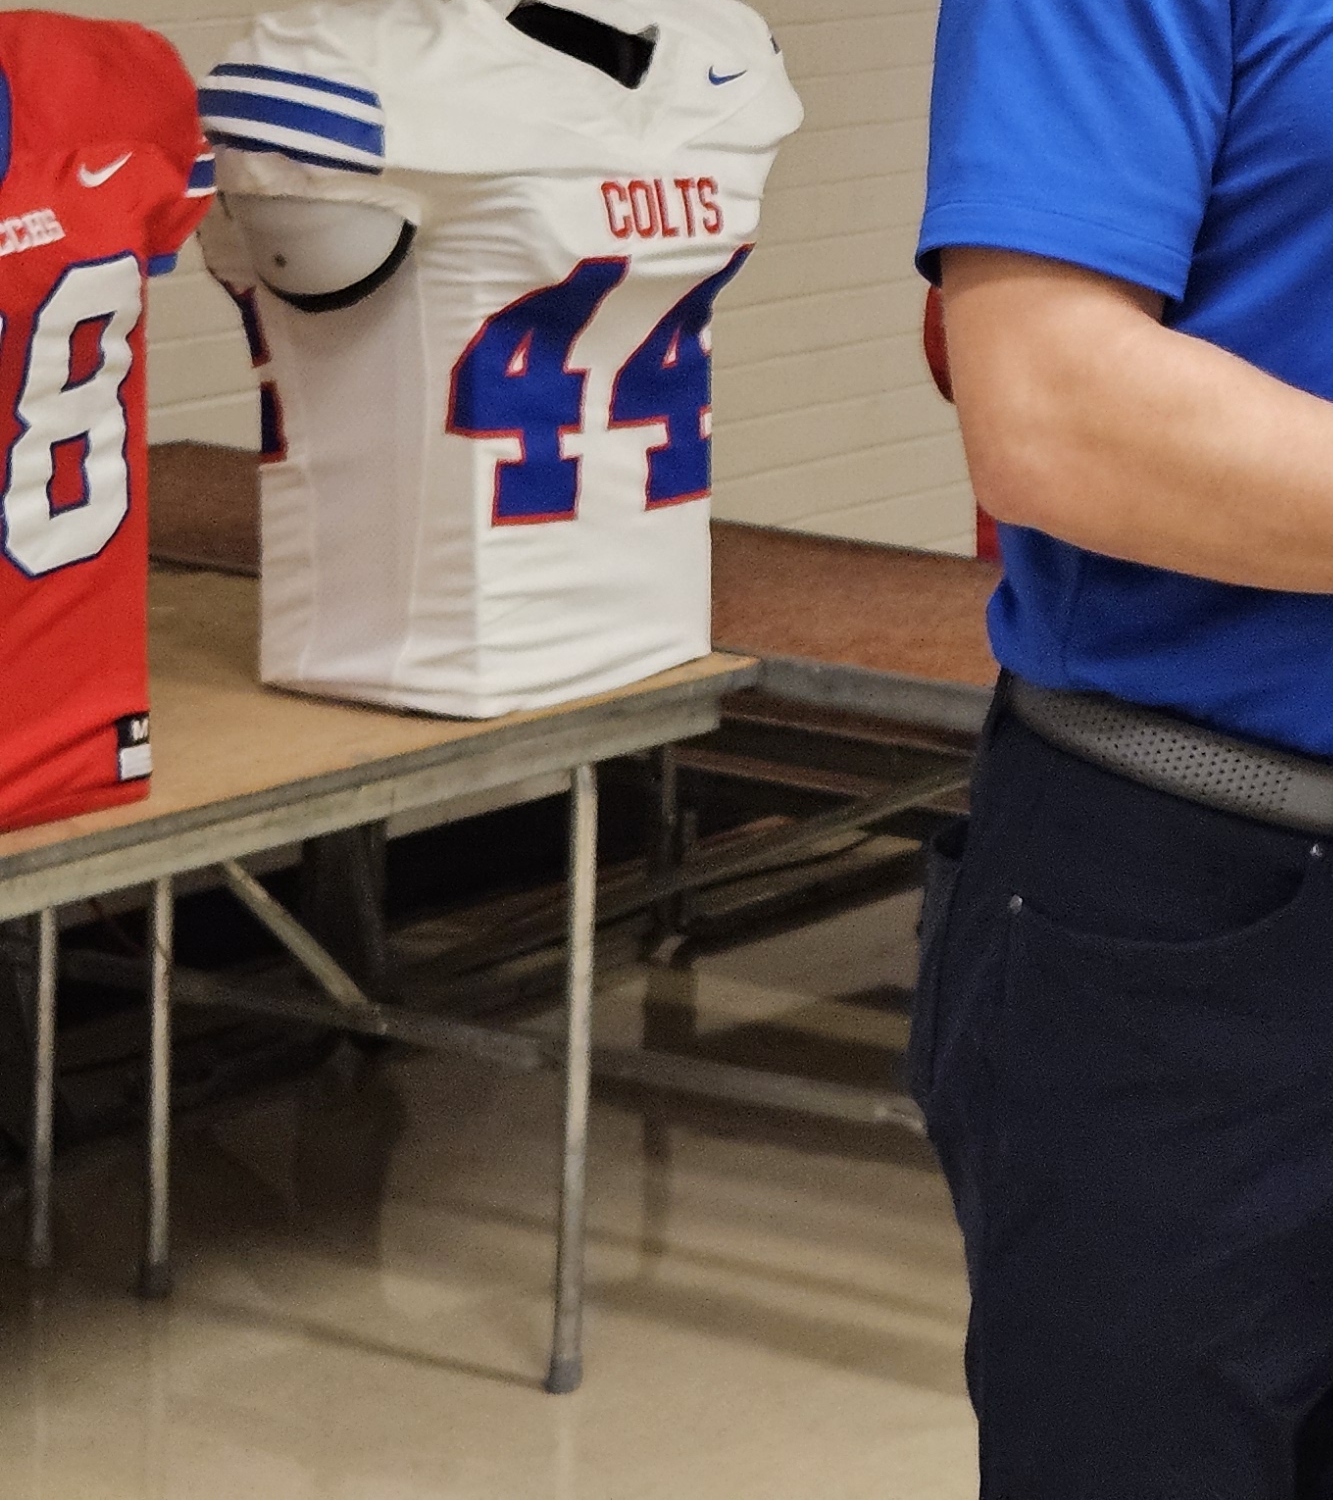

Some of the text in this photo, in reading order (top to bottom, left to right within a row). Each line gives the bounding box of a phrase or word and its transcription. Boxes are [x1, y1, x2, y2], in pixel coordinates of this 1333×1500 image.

[600, 176, 724, 239] COLTS
[0, 249, 143, 581] 8
[447, 242, 756, 527] 44
